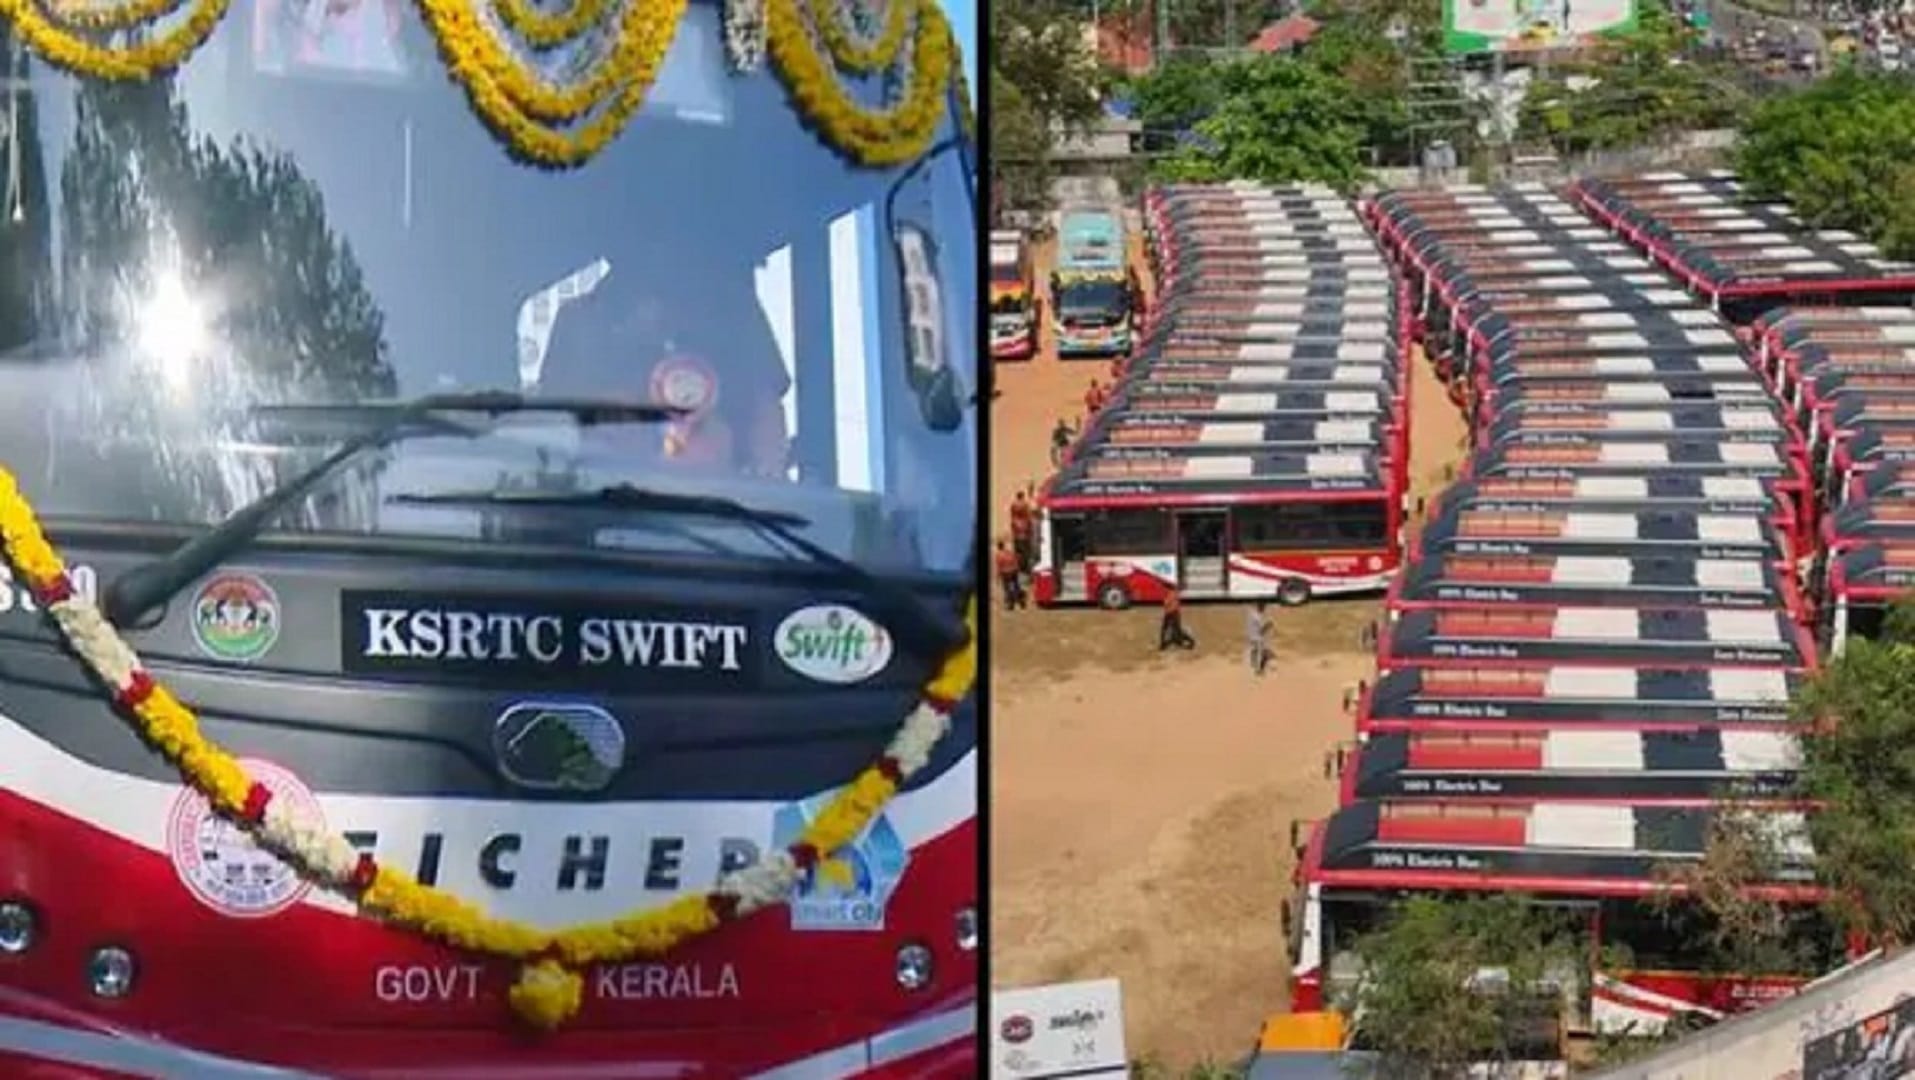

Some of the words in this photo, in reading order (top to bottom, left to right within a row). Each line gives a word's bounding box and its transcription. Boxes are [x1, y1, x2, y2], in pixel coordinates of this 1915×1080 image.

[363, 608, 563, 662] KSRTC
[579, 618, 747, 671] SWIFT
[342, 829, 761, 890] ICHER
[375, 965, 483, 1001] GOVT
[597, 963, 740, 999] KERALA
